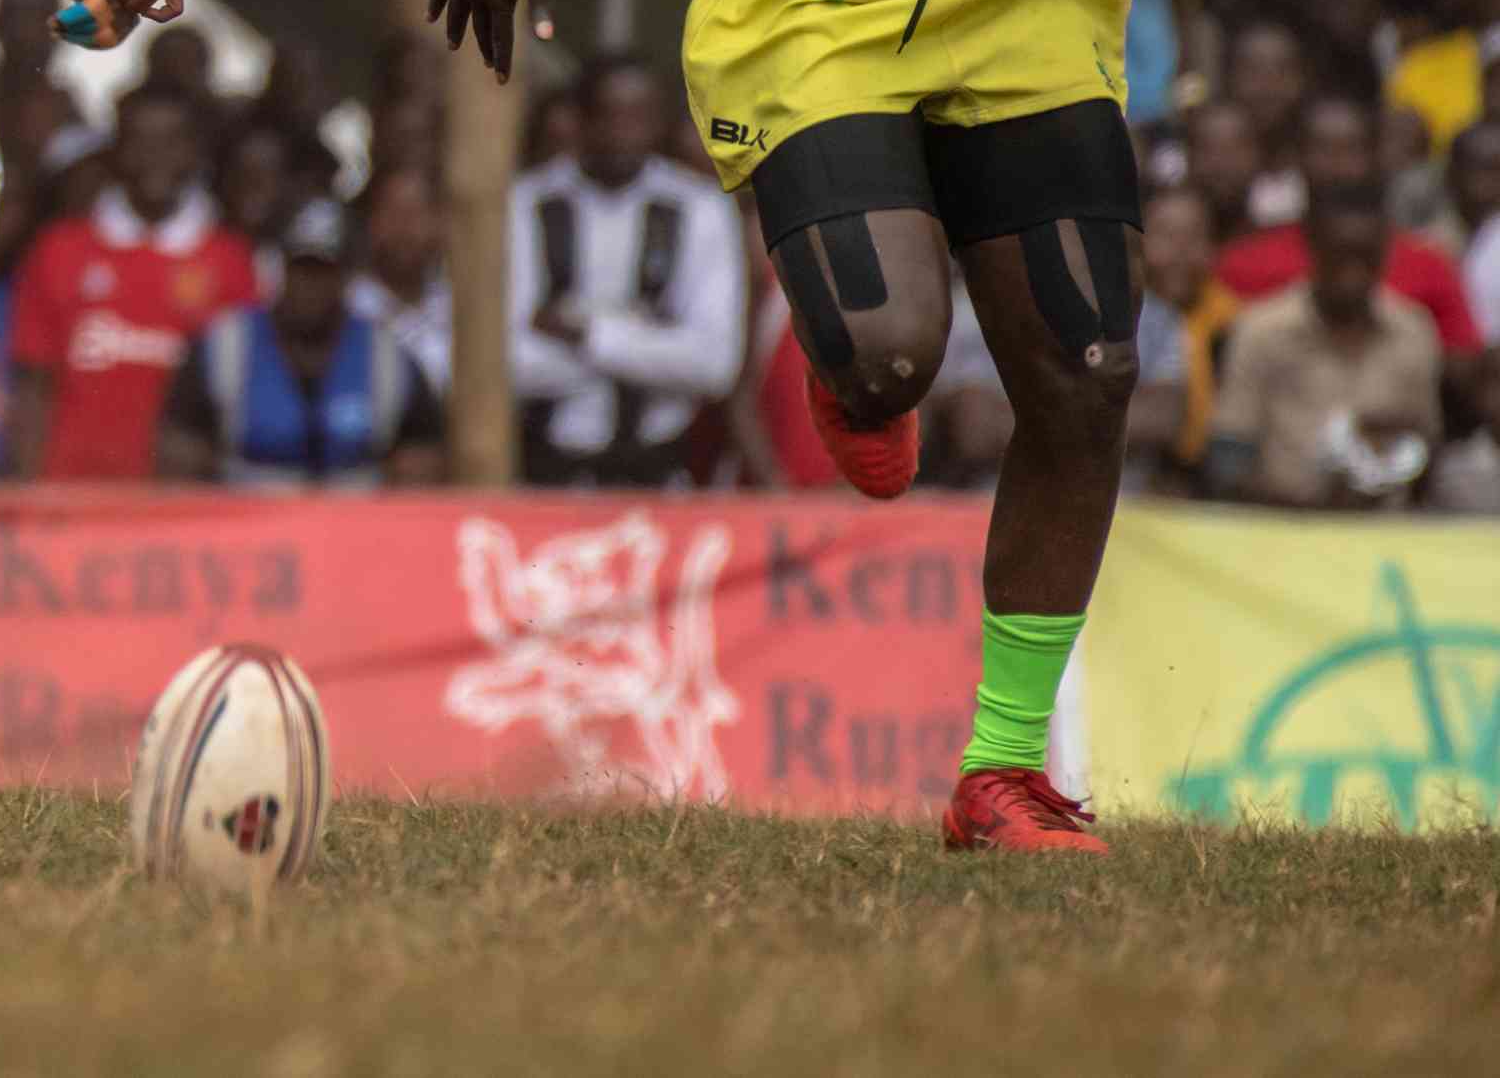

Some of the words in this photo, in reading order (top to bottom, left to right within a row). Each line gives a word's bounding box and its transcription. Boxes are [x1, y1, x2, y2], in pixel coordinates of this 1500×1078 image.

[711, 117, 770, 152] BLK
[764, 520, 986, 662] Ken
[764, 680, 970, 800] Rug
